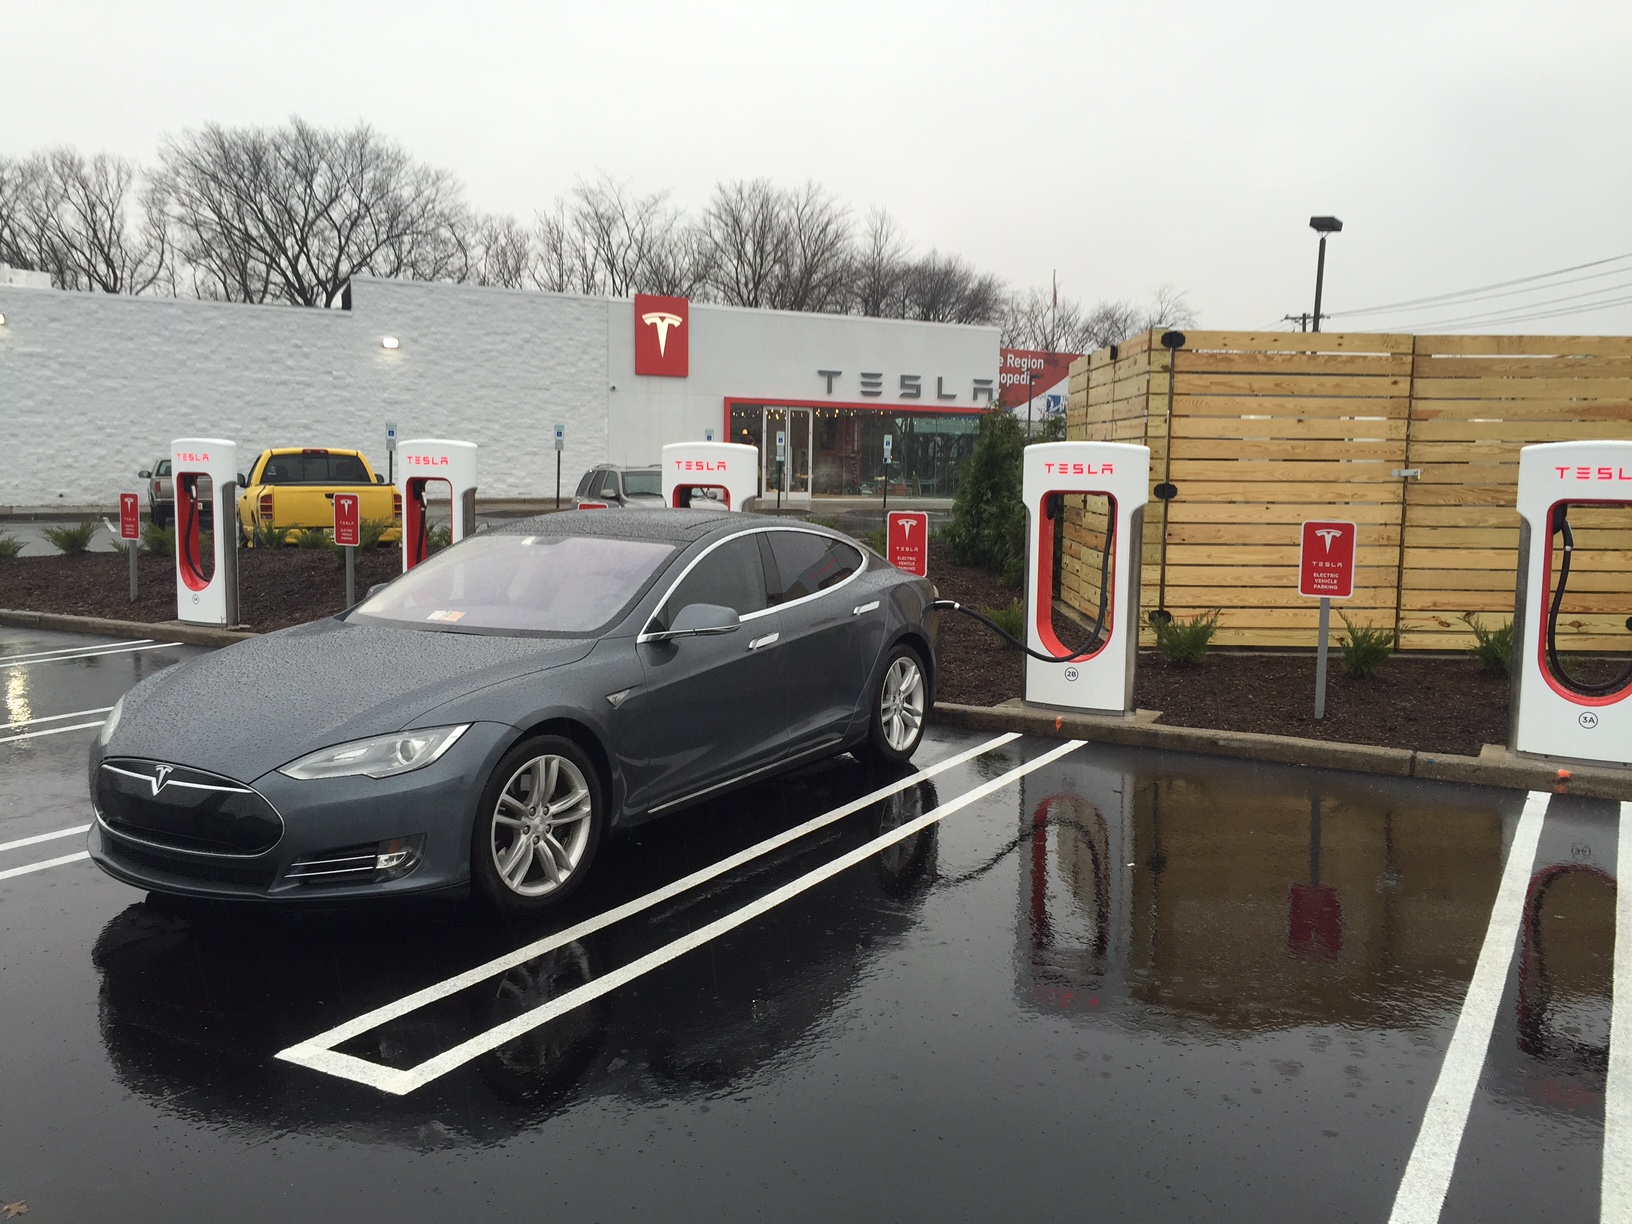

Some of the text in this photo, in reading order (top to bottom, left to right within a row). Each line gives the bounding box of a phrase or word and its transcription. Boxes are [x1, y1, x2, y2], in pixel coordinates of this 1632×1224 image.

[1007, 353, 1044, 371] Region
[817, 370, 993, 401] TESLA
[176, 453, 210, 462] TESLA
[407, 455, 449, 466] TESLA
[675, 460, 727, 471] TESLA
[1044, 463, 1114, 475] TESLA
